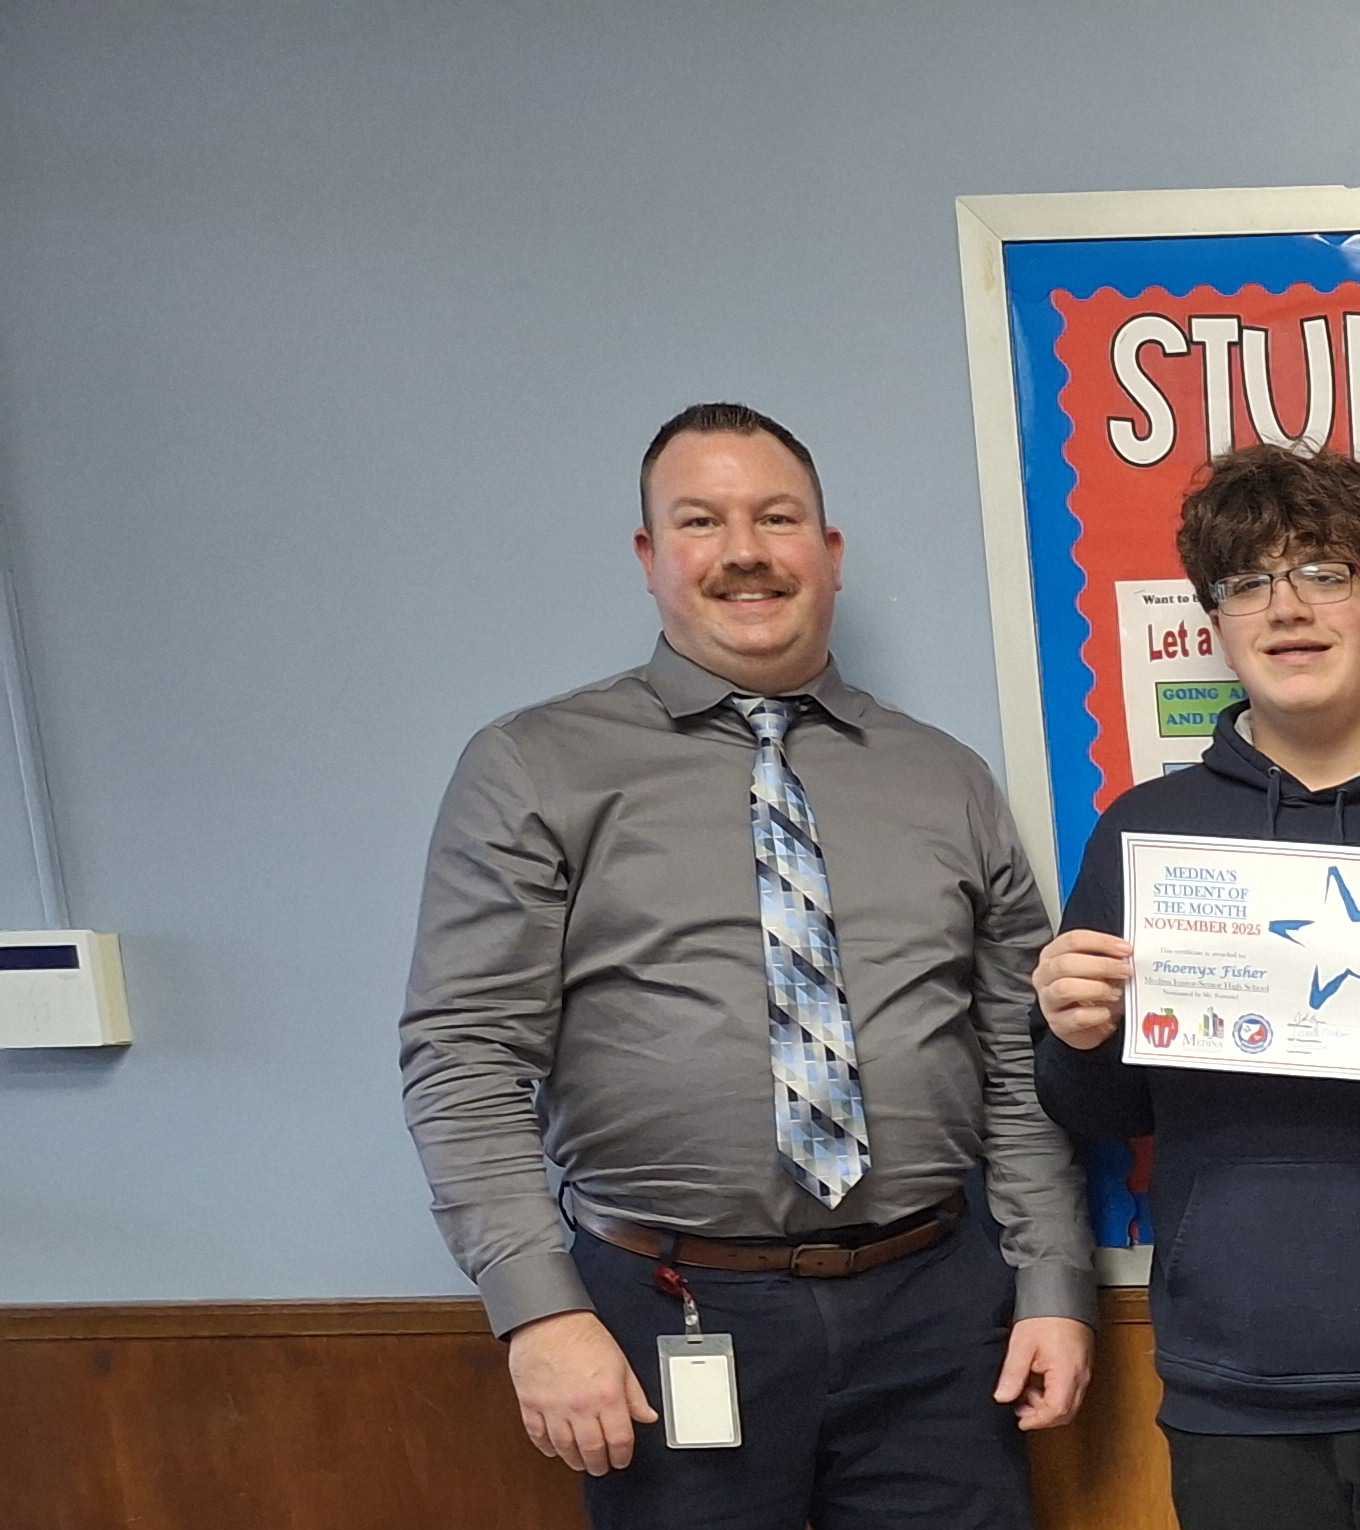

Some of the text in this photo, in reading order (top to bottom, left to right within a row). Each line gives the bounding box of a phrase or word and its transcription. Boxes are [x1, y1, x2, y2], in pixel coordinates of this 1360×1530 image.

[1143, 594, 1175, 604] Want
[1177, 594, 1190, 603] to
[1148, 620, 1212, 661] Let a
[1163, 687, 1219, 700] GOING
[1167, 713, 1204, 725] AND
[1164, 866, 1237, 881] MEDINA'S
[1153, 883, 1249, 900] STUDENT OF
[1154, 900, 1247, 917] THE MONTH
[1144, 917, 1261, 936] NOVEMBER 2025
[1152, 960, 1268, 979] Phoenyx Fisher
